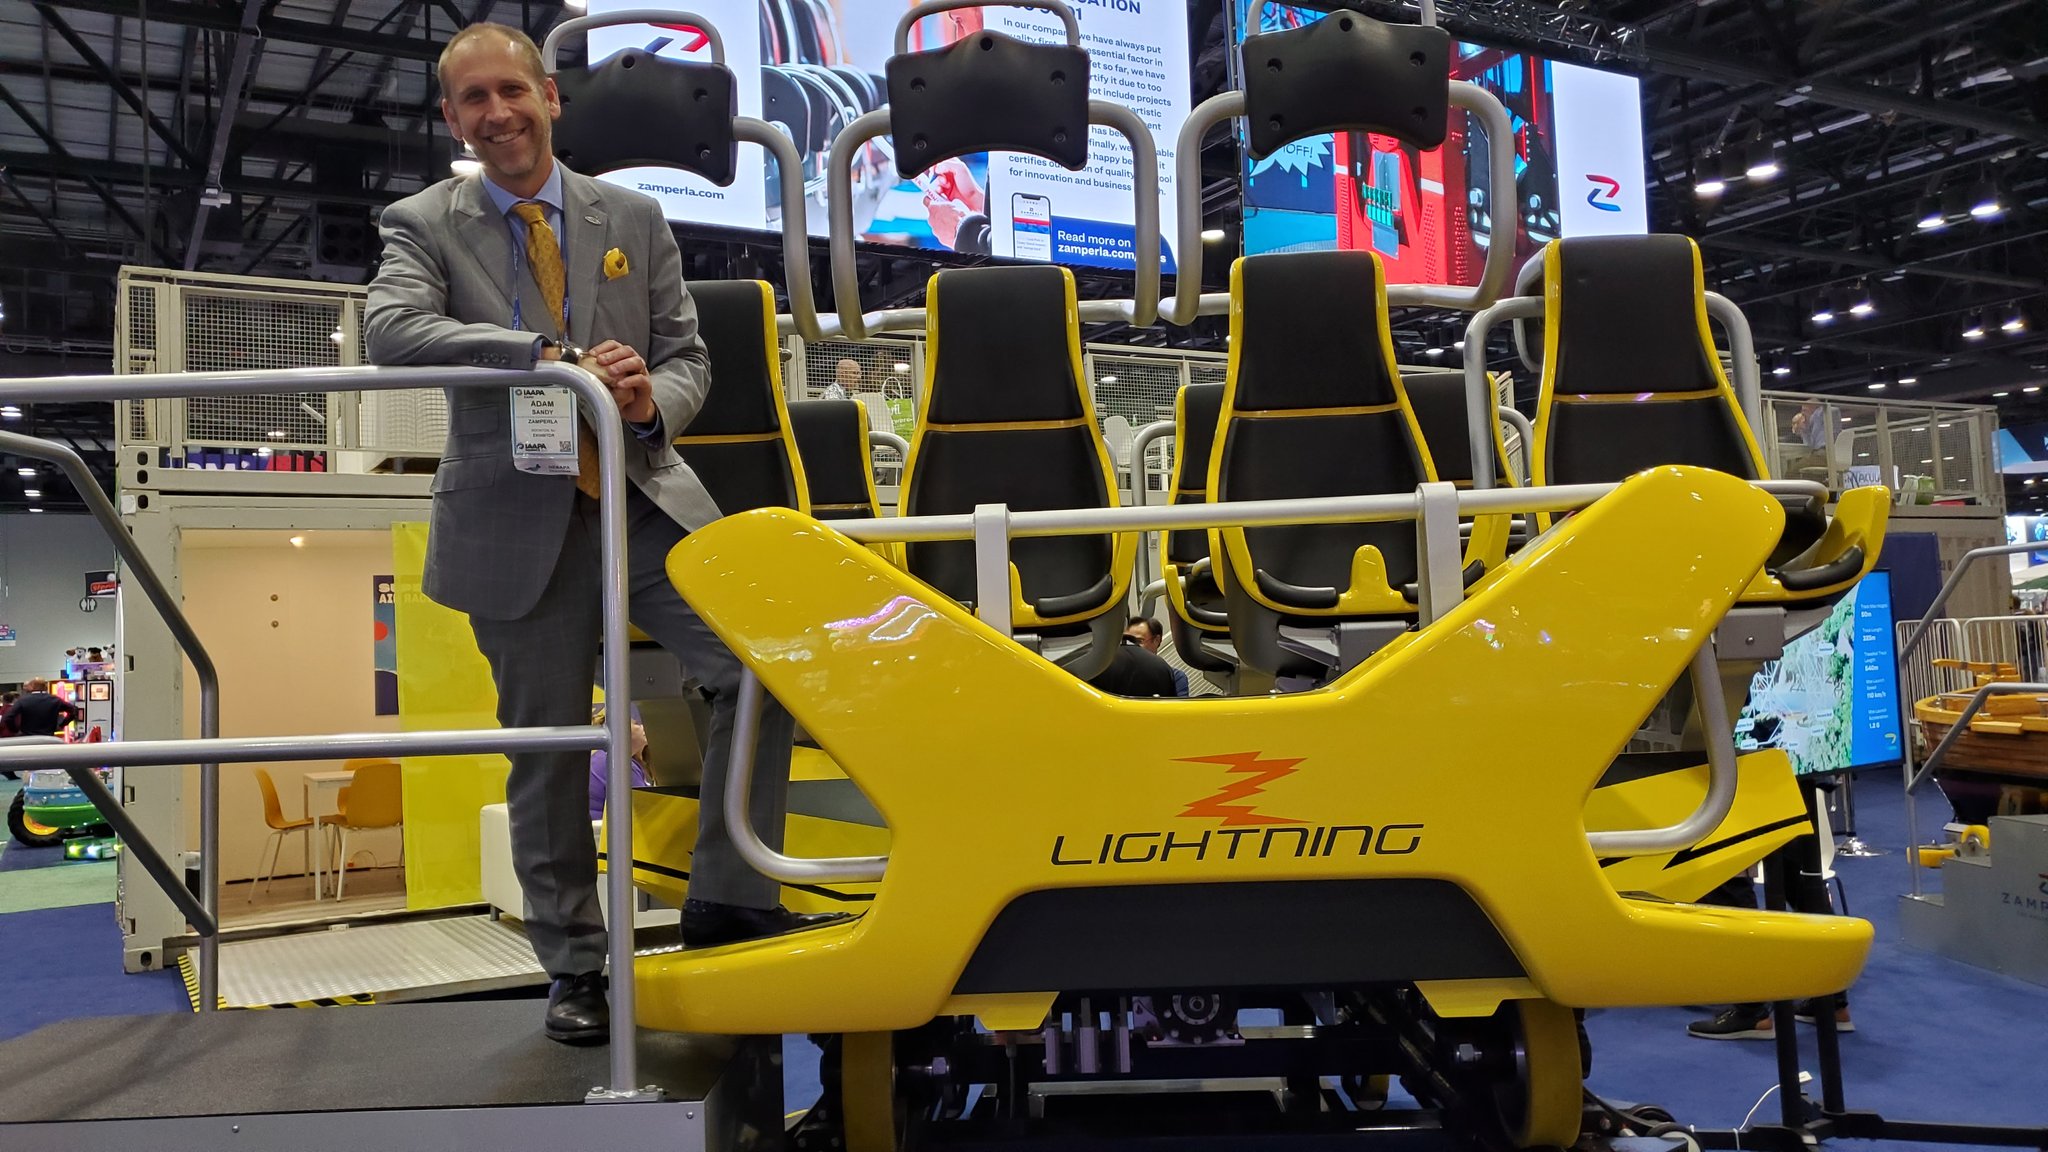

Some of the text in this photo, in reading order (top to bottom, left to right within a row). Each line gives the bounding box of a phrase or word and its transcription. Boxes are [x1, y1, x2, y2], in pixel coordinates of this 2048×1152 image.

[1003, 17, 1013, 27] In
[1014, 20, 1031, 30] our
[1092, 33, 1114, 46] have
[1115, 38, 1145, 52] always
[1146, 44, 1162, 55] put
[1127, 53, 1154, 66] factor
[1154, 58, 1163, 67] in
[1102, 63, 1114, 72] so
[1114, 64, 1130, 76] far,
[1130, 68, 1144, 77] we
[1145, 69, 1166, 80] have
[1110, 76, 1118, 85] it
[1118, 77, 1136, 88] due
[1136, 81, 1146, 90] to
[1147, 83, 1162, 93] too
[1103, 87, 1135, 101] include
[1136, 95, 1172, 107] projects
[1091, 126, 1108, 136] has
[1088, 138, 1118, 152] finally,
[1008, 155, 1048, 167] certifies
[1094, 166, 1104, 174] of
[1105, 168, 1135, 181] quality
[1158, 175, 1173, 184] ool
[1093, 152, 1121, 165] happy
[1159, 161, 1166, 170] it
[1009, 167, 1132, 192] for innovation and business
[637, 182, 725, 200] zamperla.com
[1057, 230, 1131, 248] Read more on
[1050, 822, 1425, 867] LIGHTNING
